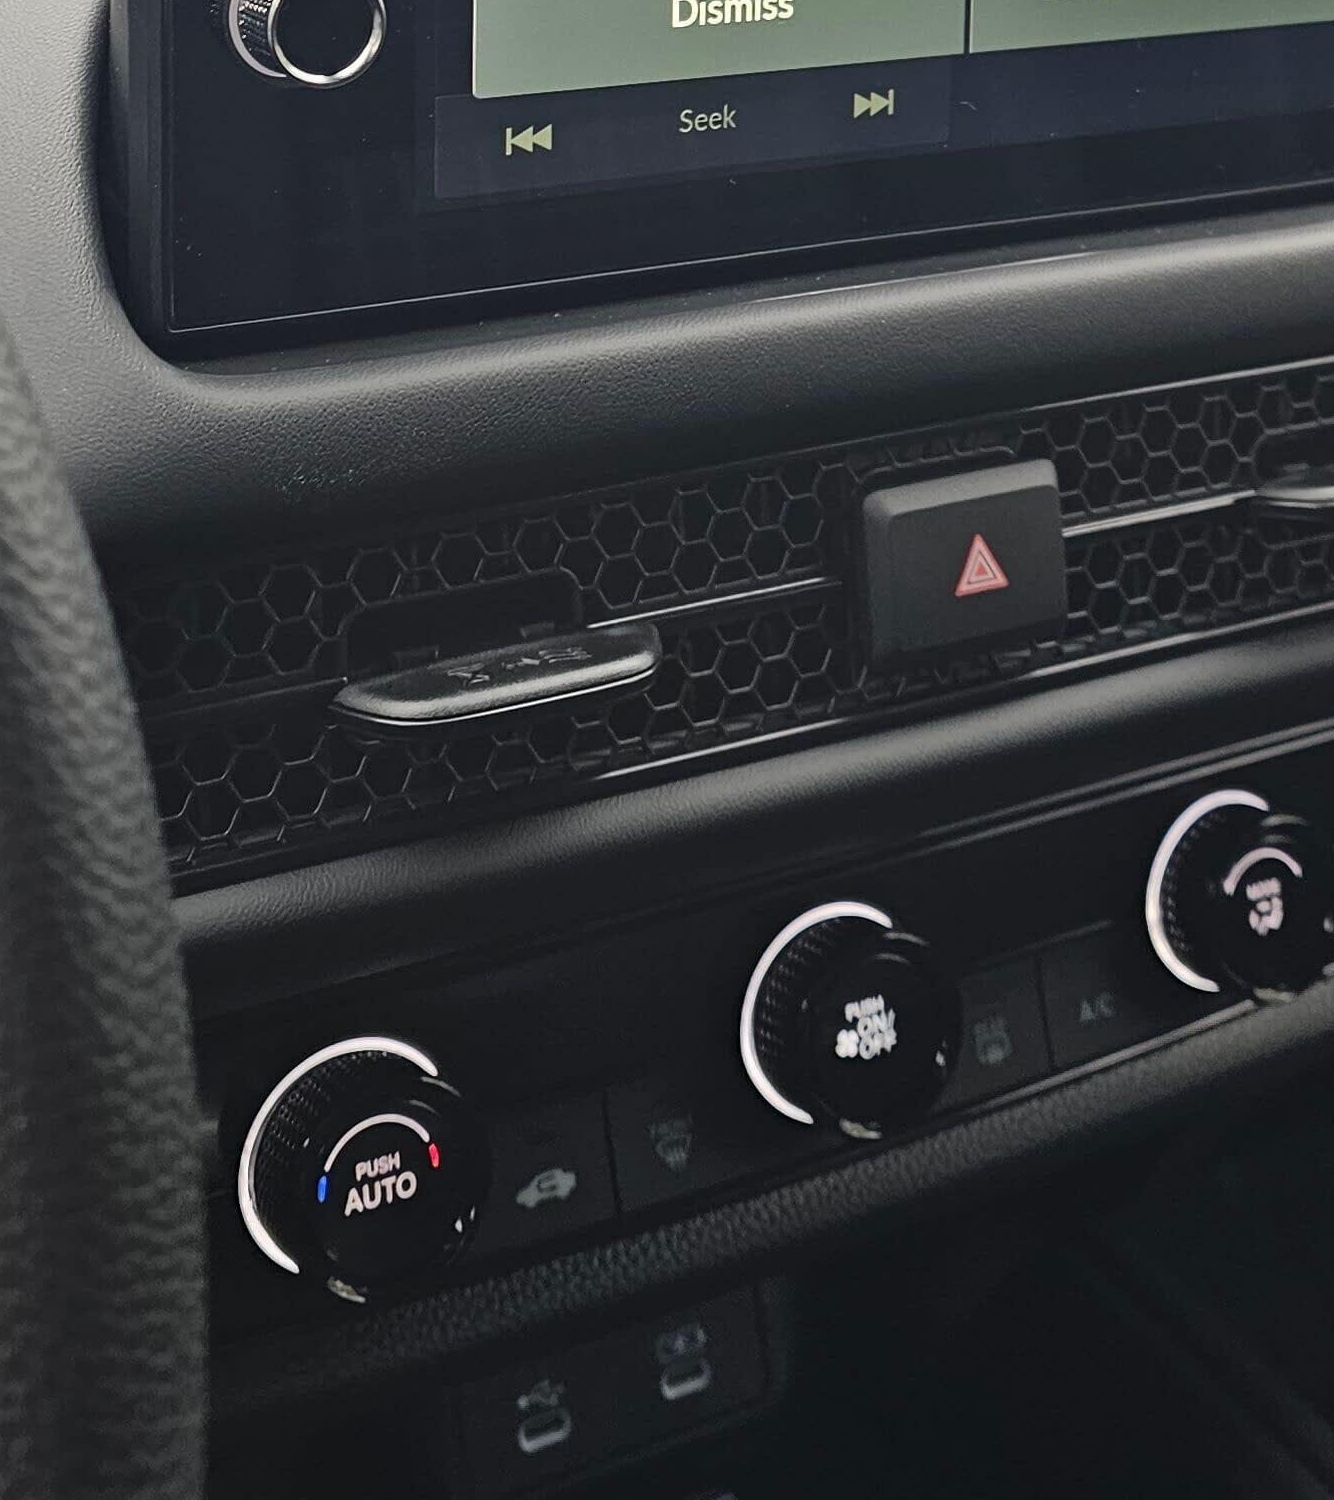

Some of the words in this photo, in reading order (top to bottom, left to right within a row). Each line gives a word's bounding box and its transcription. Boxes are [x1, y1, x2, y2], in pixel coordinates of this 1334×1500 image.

[678, 103, 737, 133] Seek
[355, 1151, 401, 1181] PUSH
[344, 1170, 418, 1217] AUTO
